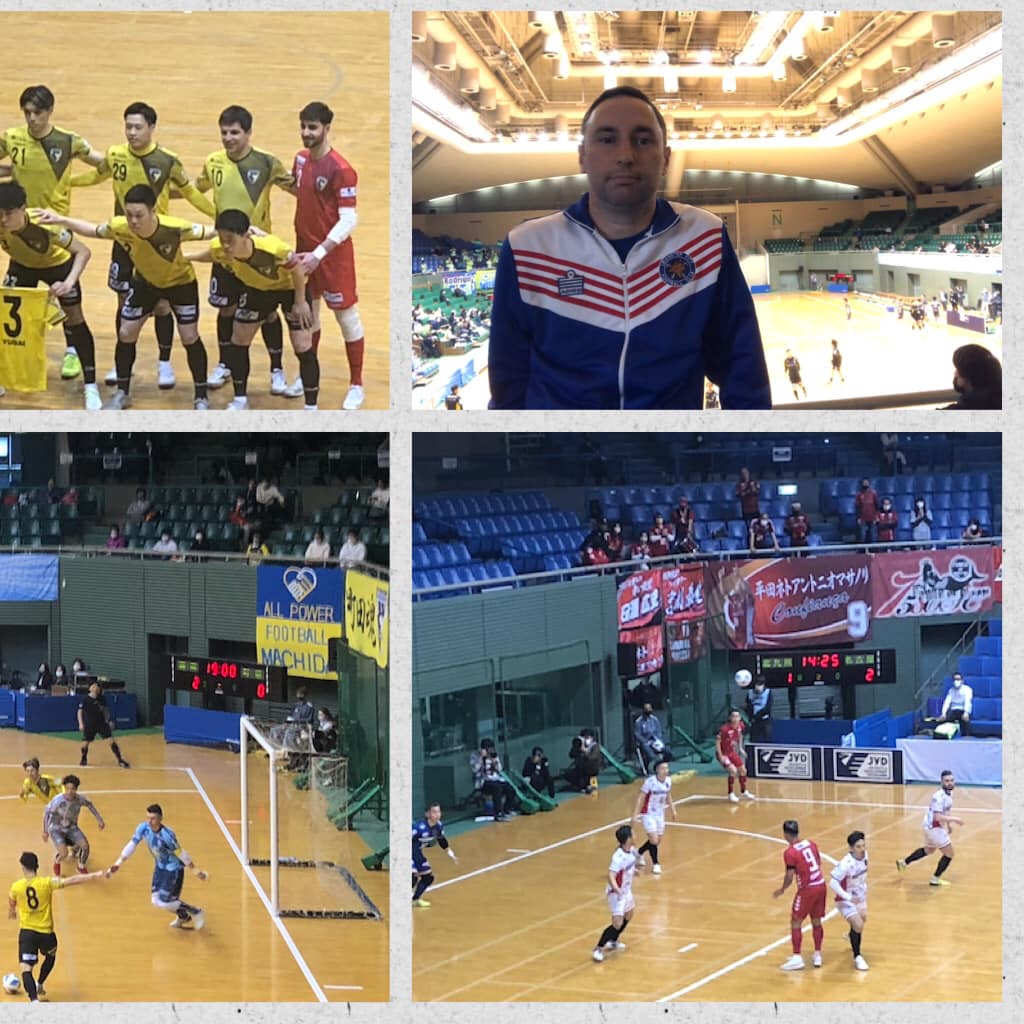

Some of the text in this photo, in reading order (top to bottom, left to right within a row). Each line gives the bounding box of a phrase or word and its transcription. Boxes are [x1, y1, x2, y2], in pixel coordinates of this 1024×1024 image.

[11, 147, 26, 166] 21
[112, 162, 127, 182] 29
[3, 294, 22, 338] 3
[264, 600, 335, 623] ALL POWER
[847, 600, 869, 638] 9
[266, 624, 328, 646] FOOTBALL
[801, 653, 840, 668] 14:25
[865, 667, 875, 683] 2
[802, 848, 820, 872] 9
[26, 886, 39, 910] 8
